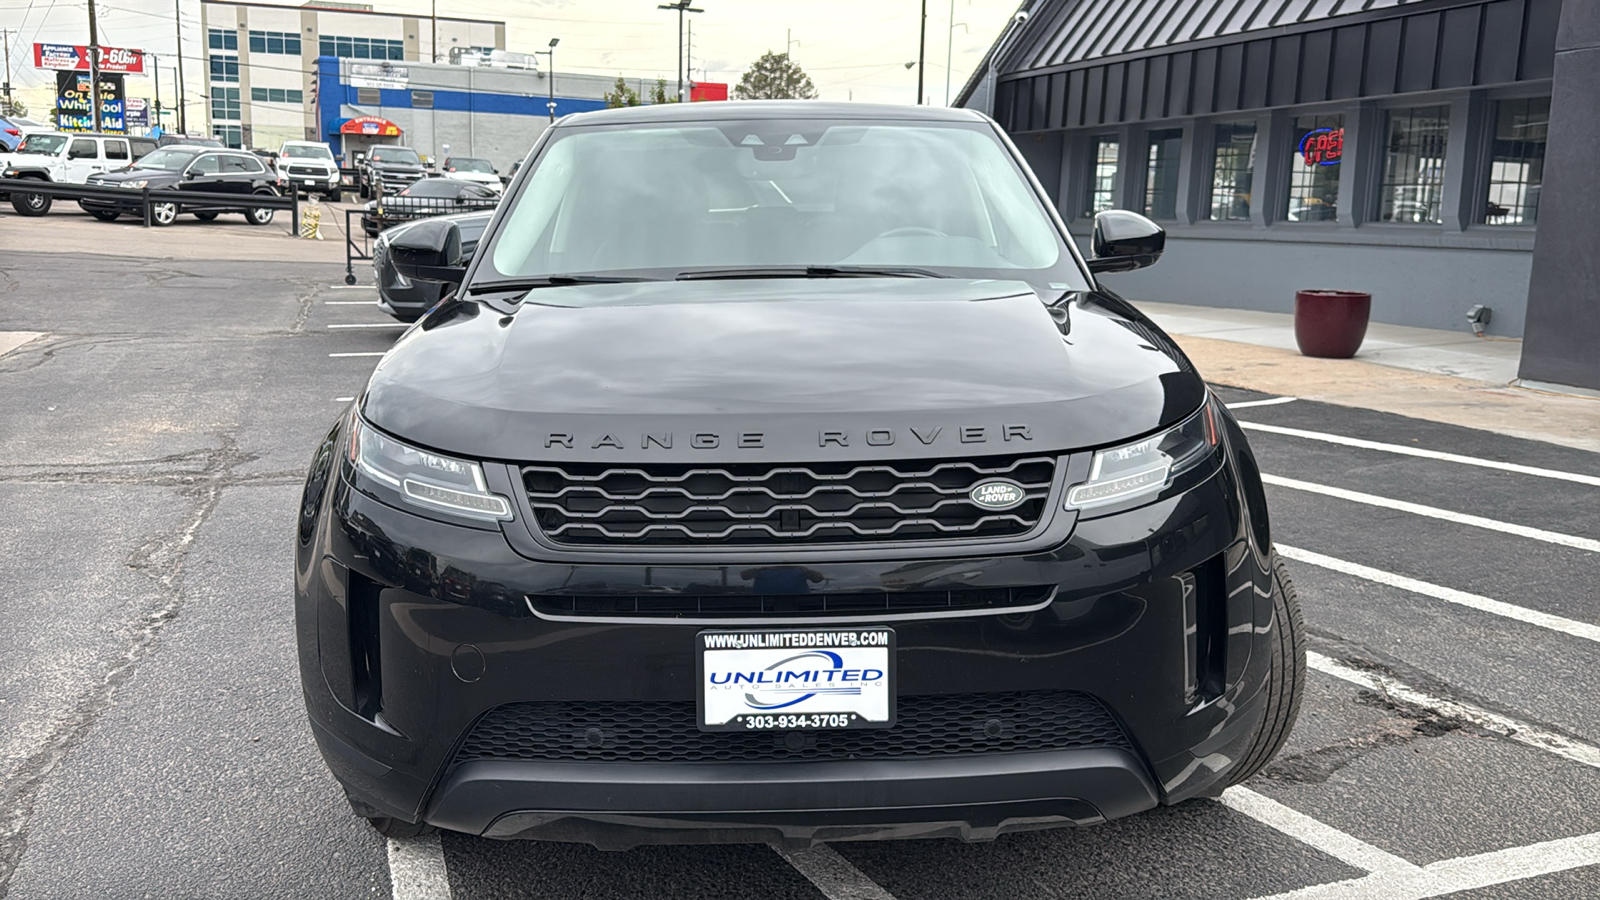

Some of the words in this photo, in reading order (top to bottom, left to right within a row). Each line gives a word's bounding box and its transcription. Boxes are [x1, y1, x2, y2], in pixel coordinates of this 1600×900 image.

[64, 90, 83, 98] On
[59, 99, 121, 113] Whirool
[544, 431, 764, 449] RANGE
[818, 424, 1033, 447] ROVER
[981, 486, 1007, 495] LAND
[985, 493, 1016, 502] ROVER
[704, 632, 888, 648] WWW.UNLIMITEDDENVER.COM
[710, 669, 883, 684] UNLIMITED
[746, 714, 849, 729] 303-934-3705
